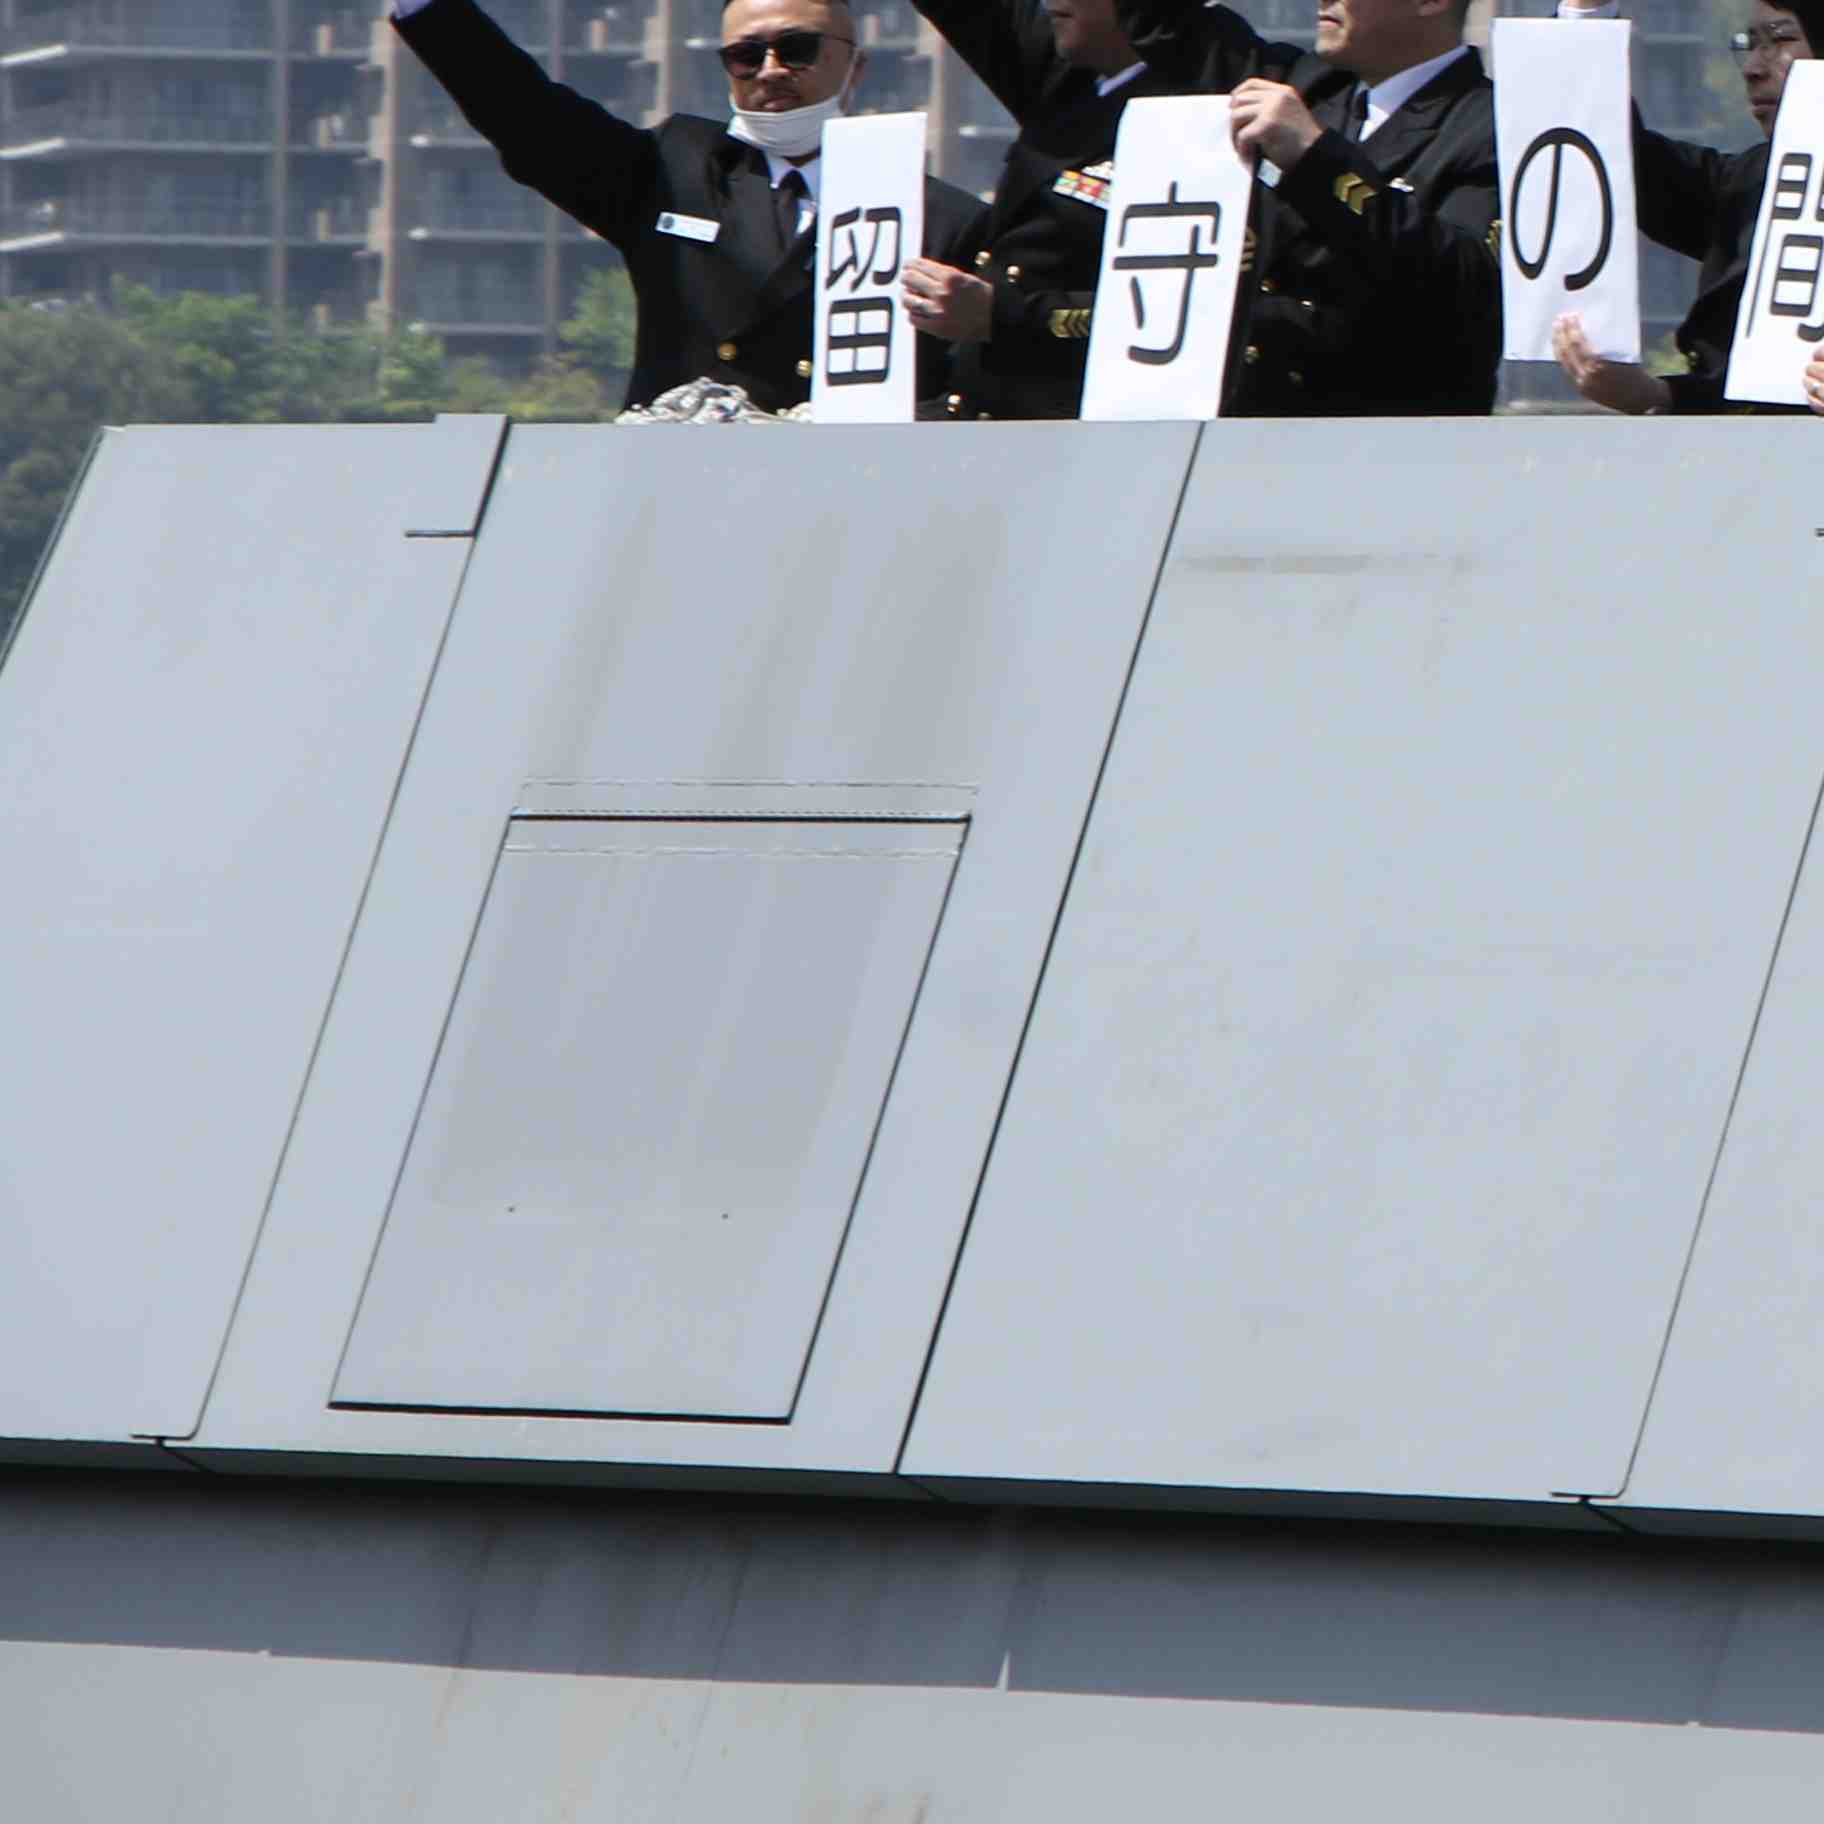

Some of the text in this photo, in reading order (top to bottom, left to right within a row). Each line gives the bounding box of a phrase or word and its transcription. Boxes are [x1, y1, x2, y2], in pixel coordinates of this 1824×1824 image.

[825, 206, 902, 387] 留
[1113, 182, 1221, 366] 守
[1509, 126, 1614, 292] の
